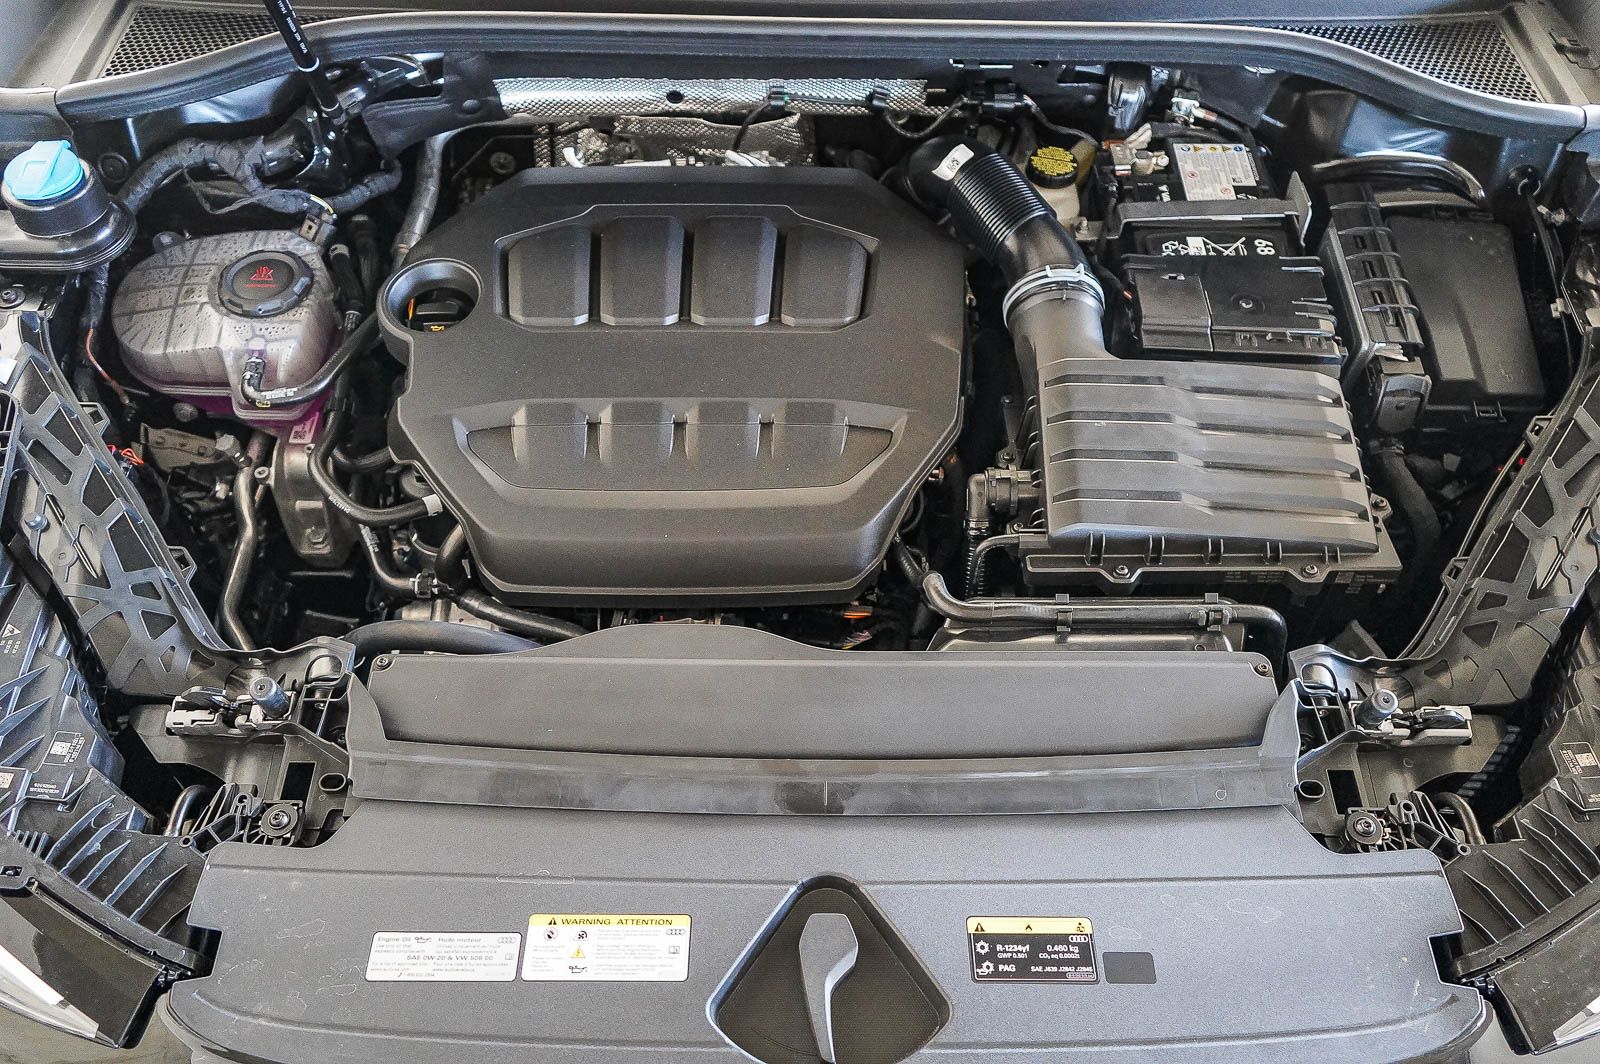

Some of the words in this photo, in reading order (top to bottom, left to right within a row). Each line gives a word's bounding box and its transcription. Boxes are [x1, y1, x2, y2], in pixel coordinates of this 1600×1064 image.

[561, 918, 611, 926] WARNING
[616, 918, 673, 926] ATTENTION
[377, 936, 400, 944] Engine
[996, 944, 1030, 953] R-1234yf
[1069, 944, 1079, 953] kg
[998, 964, 1016, 972] PAG
